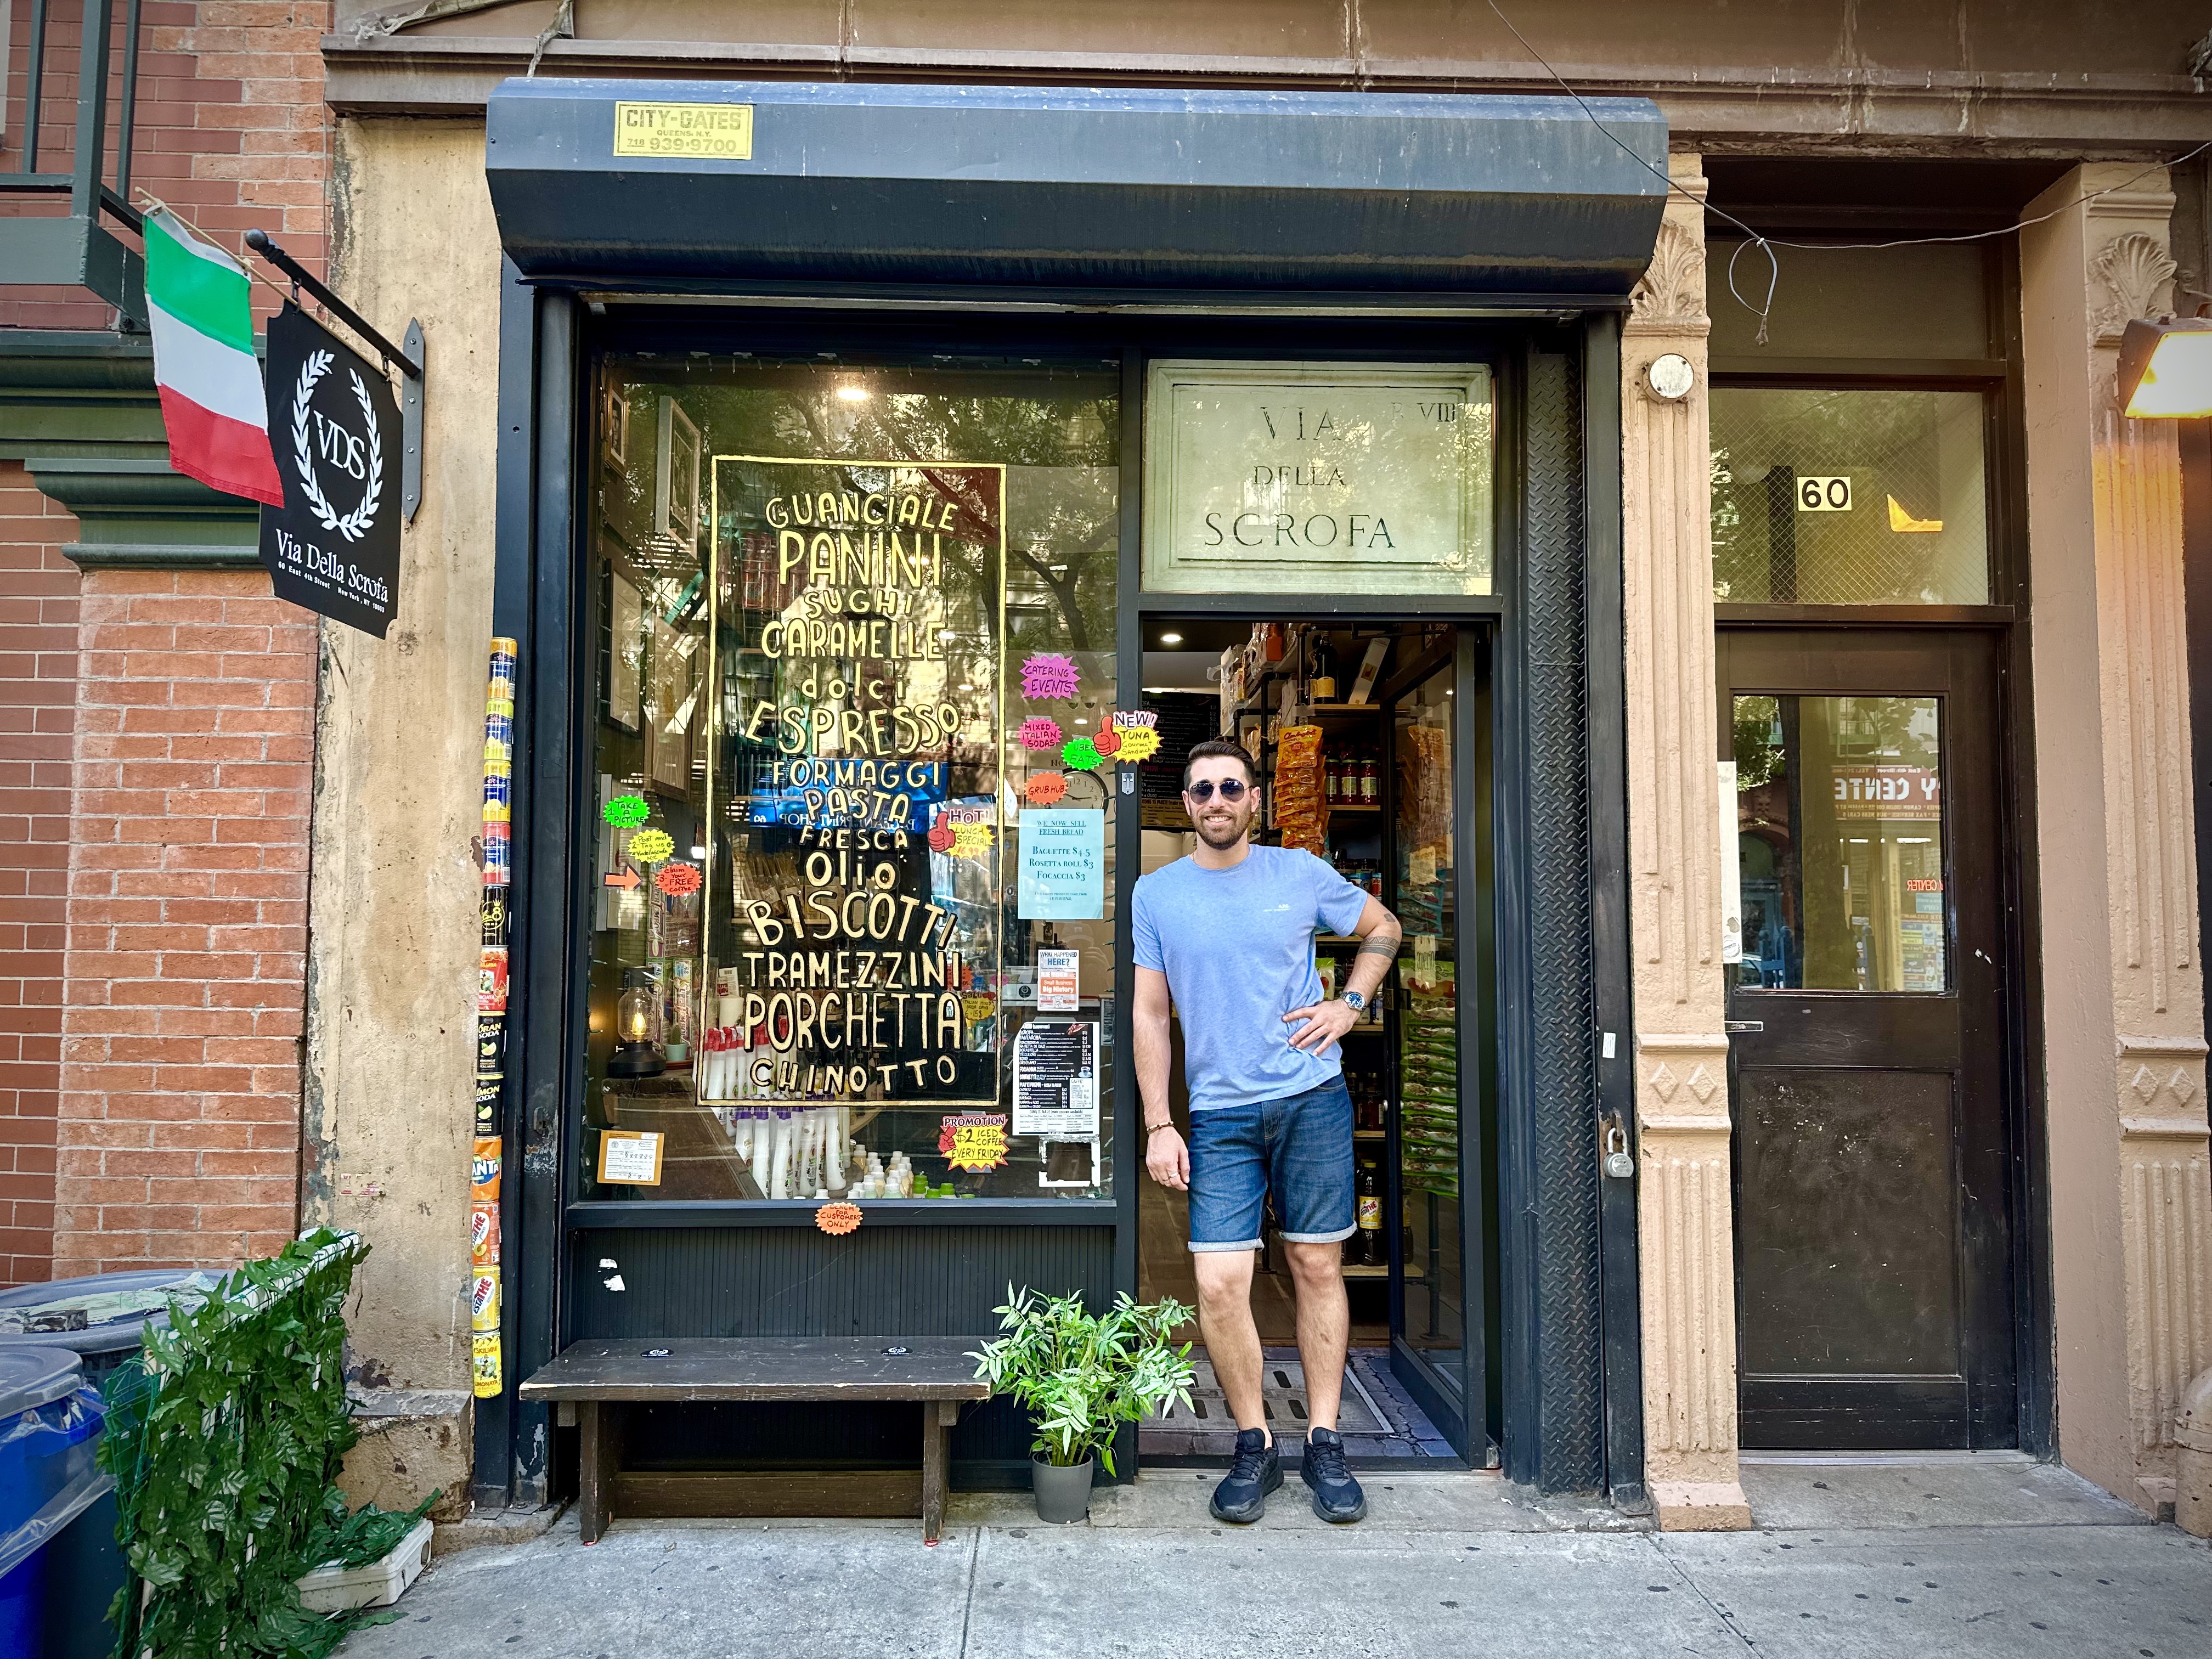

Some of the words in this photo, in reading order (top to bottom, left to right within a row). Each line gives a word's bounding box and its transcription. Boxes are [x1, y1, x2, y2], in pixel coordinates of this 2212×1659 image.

[627, 109, 742, 130] CITY-GATES
[1260, 406, 1342, 441] VIA
[313, 410, 365, 479] VDS
[1252, 466, 1347, 486] DELLA
[1801, 478, 1850, 510] 60
[765, 492, 959, 531] GUANCIALE
[1204, 512, 1396, 549] SCROFA
[275, 528, 302, 564] Via
[306, 543, 345, 584] Della
[348, 563, 388, 603] Scrofa
[778, 529, 943, 588] PANINI
[278, 561, 285, 570] 60
[289, 565, 301, 577] East
[304, 572, 313, 582] 4th
[314, 576, 330, 589] Street
[337, 586, 348, 597] New
[363, 598, 370, 606] NY
[804, 589, 913, 618] SUGHI
[761, 619, 947, 658] CARAMELLE
[1025, 664, 1069, 678] CATERING
[802, 662, 906, 701] dolci
[1031, 679, 1073, 693] EVENTS
[745, 700, 962, 756] ESPRESSO
[1115, 712, 1156, 729] NEW!
[1022, 730, 1057, 740] ITALIAN
[1120, 730, 1149, 740] TUNA
[1027, 739, 1056, 748] SODAS
[1069, 754, 1098, 766] EATS
[772, 759, 941, 788] FORMAGGI
[1028, 786, 1049, 795] GRUB
[1050, 784, 1064, 794] HUB
[615, 800, 639, 810] TAKE
[804, 788, 912, 822] PASTA
[638, 835, 653, 843] Post
[799, 827, 910, 850] FRESCA
[955, 826, 984, 836] LUNCH
[956, 835, 990, 847] SPECIAL
[805, 851, 896, 890] Olio
[1084, 859, 1093, 870] $3
[669, 878, 693, 886] FREE
[1075, 871, 1085, 882] $3
[747, 890, 958, 949] BISCOTTI
[742, 951, 962, 988] TRAMEZZINI
[1047, 958, 1070, 967] HERE?
[1042, 985, 1052, 994] Big
[744, 991, 962, 1050] PORCHETTA
[478, 1030, 500, 1039] SODA
[750, 1055, 957, 1094] CHINOTTO
[476, 1093, 496, 1103] SODA
[944, 1116, 1005, 1127] PROMOTION
[956, 1127, 975, 1143] $2
[977, 1128, 998, 1138] ICED
[976, 1137, 1003, 1146] COFFEE
[952, 1148, 975, 1159] EVERY
[978, 1148, 1003, 1159] FRIDAY
[820, 1211, 861, 1220] CUSTOMERS
